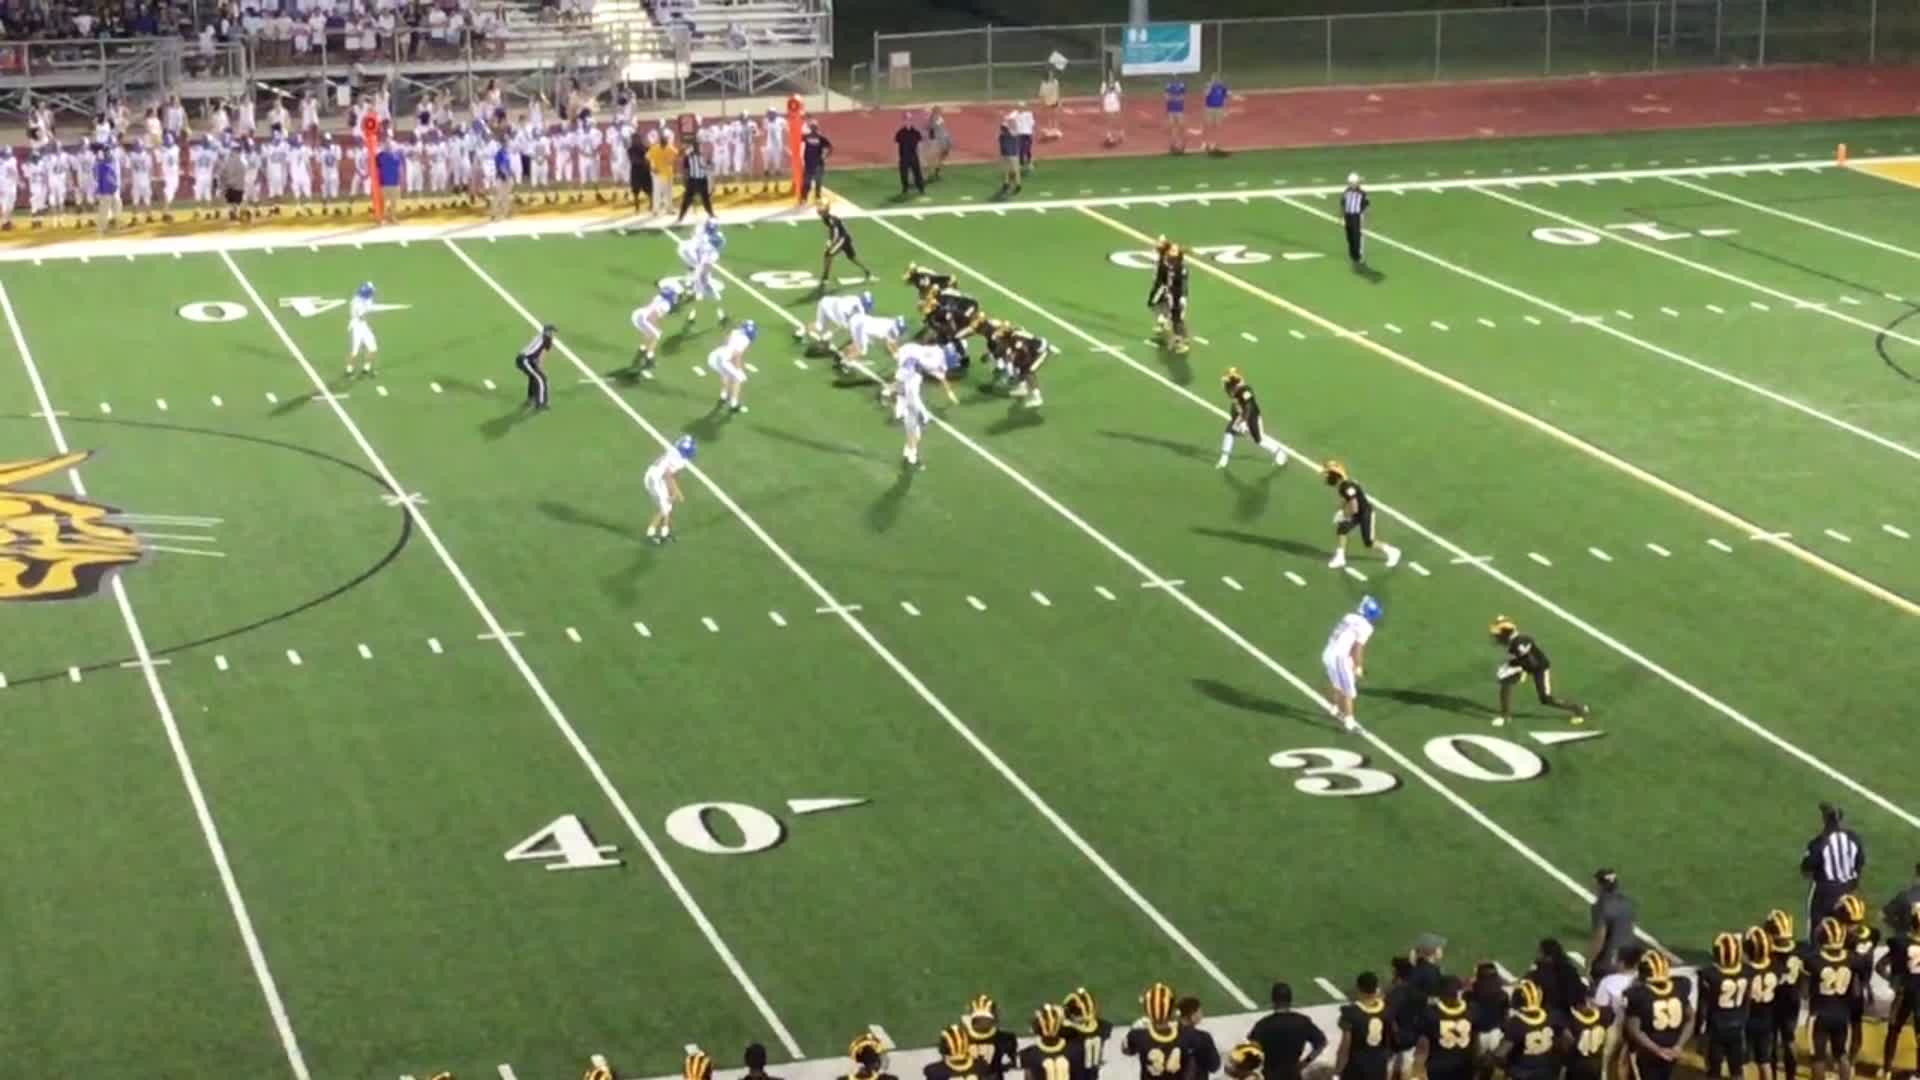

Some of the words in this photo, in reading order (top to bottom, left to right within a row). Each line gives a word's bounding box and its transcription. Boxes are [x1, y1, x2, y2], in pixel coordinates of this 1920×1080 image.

[178, 296, 347, 322] 40
[1269, 734, 1543, 796] 30
[504, 801, 784, 870] 40
[1439, 1019, 1471, 1049] 53
[1147, 1048, 1181, 1076] 34
